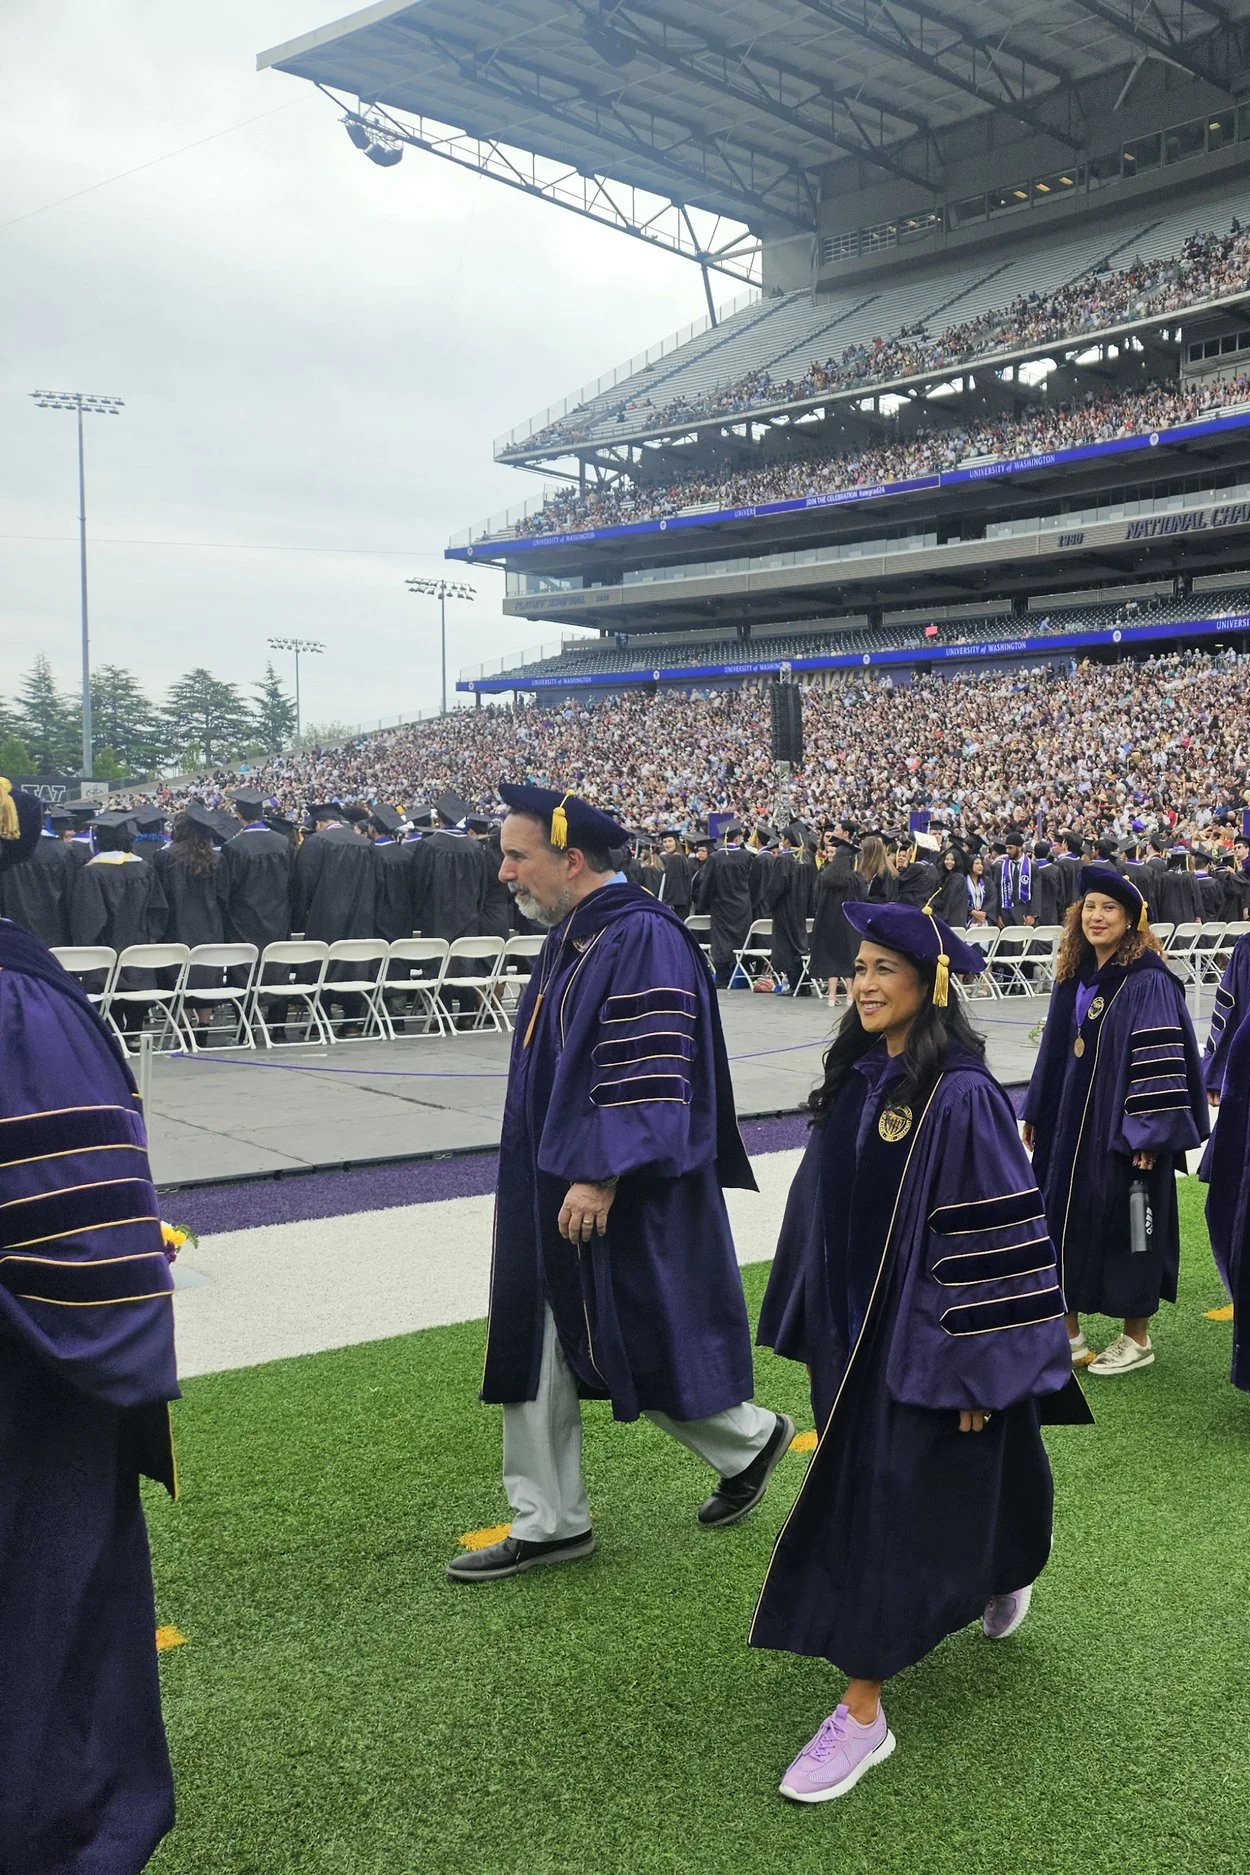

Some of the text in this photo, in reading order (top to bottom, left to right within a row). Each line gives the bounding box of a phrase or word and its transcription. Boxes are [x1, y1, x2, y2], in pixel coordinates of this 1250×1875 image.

[969, 464, 1005, 479] UNIVERSITY
[1013, 454, 1055, 469] WASHINGTON
[1125, 512, 1206, 540] NATIONAL
[945, 645, 979, 656] UNIVERSITY
[988, 641, 1026, 653] WASHINGTON
